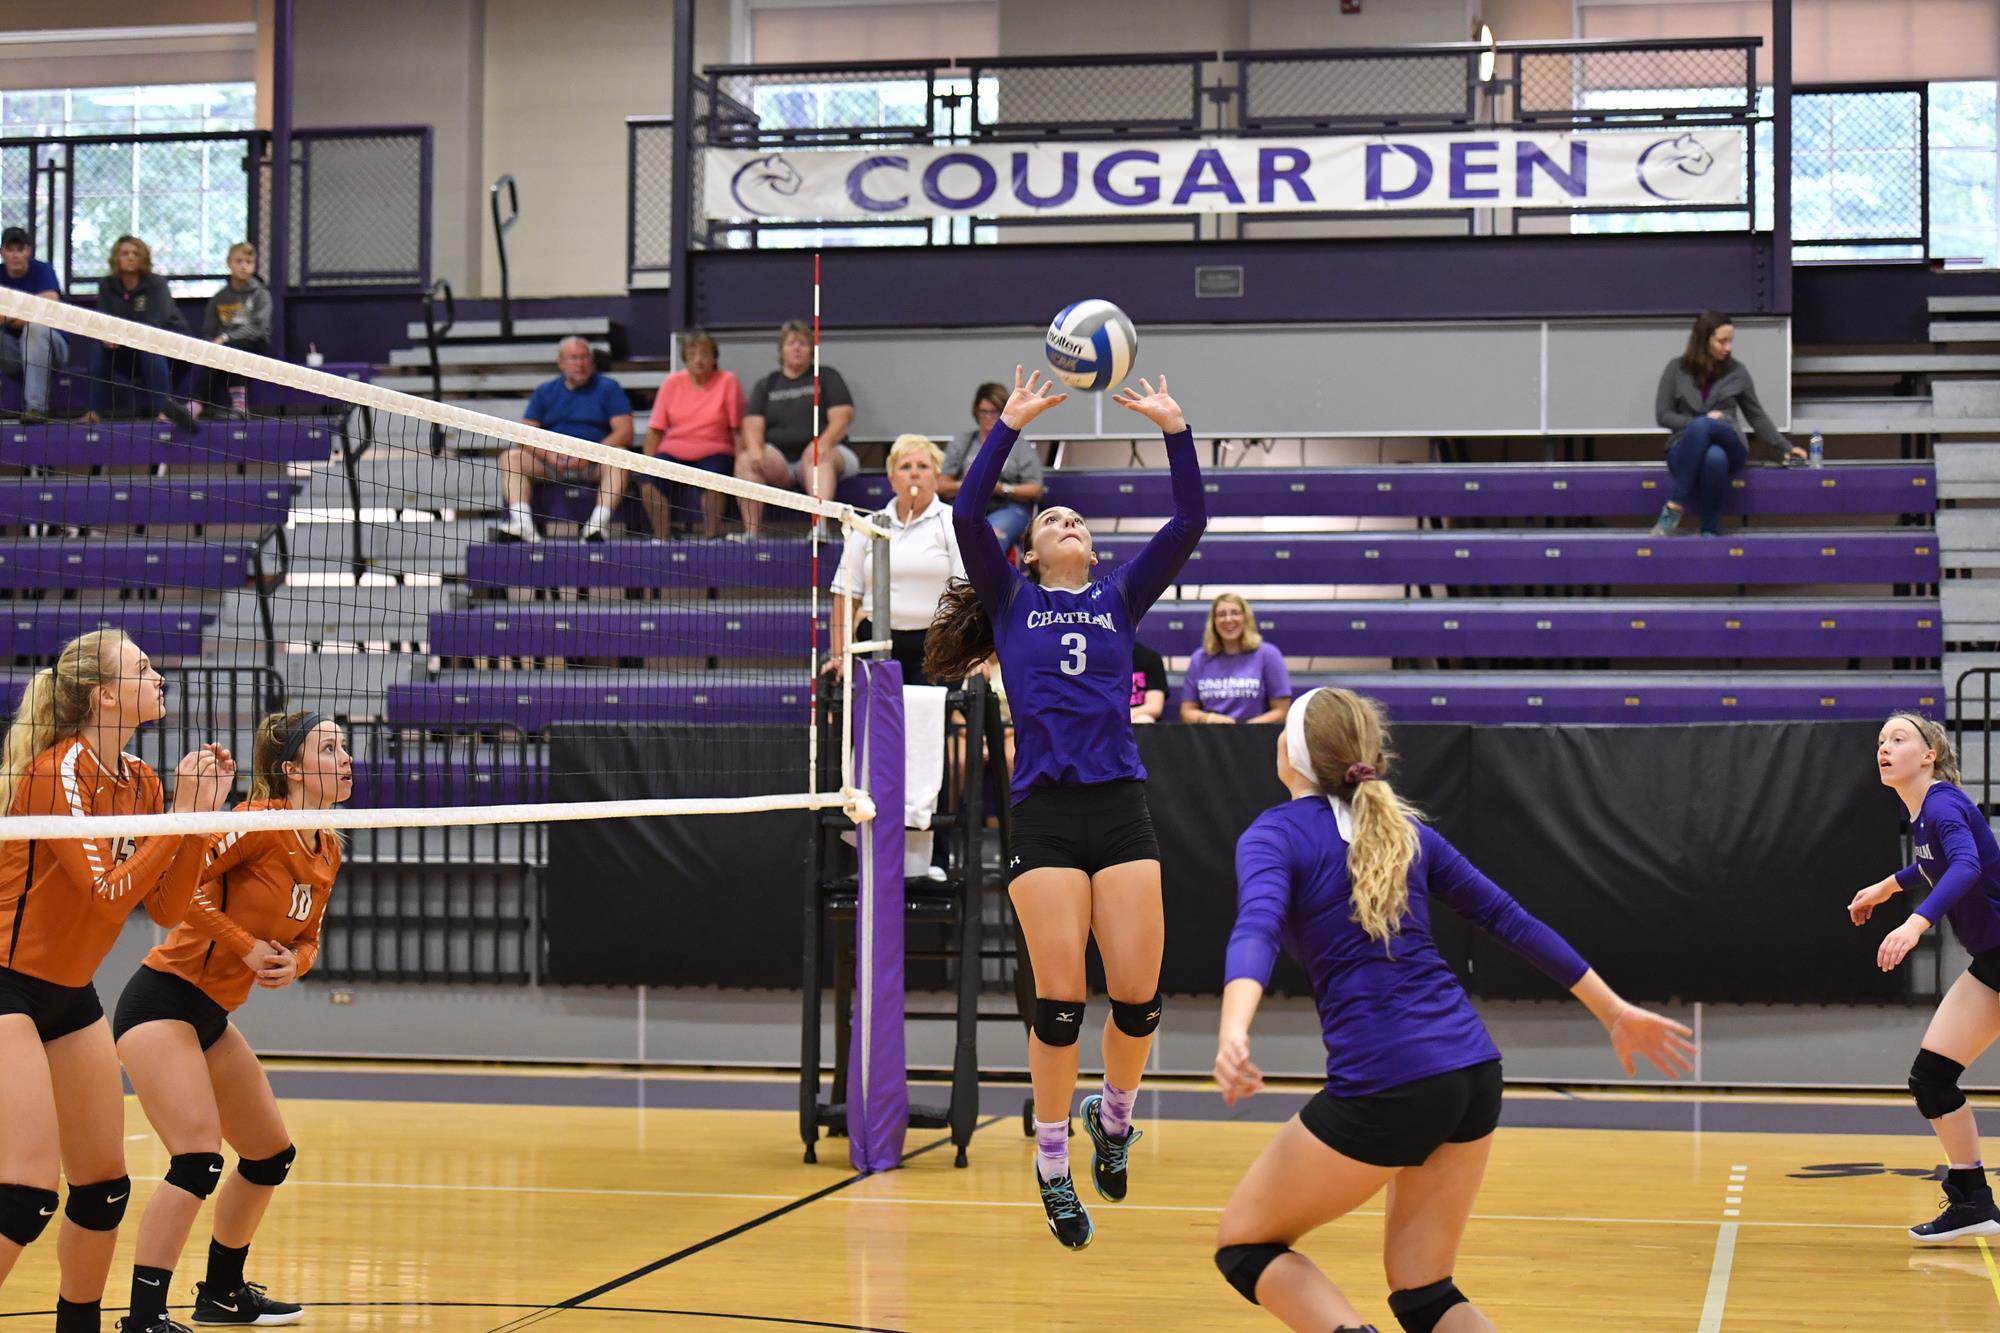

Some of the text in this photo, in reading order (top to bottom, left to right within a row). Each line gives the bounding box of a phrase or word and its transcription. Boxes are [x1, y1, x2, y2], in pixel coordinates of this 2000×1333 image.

[846, 140, 1588, 211] COUGAR DEN
[1060, 632, 1087, 676] 3
[287, 881, 313, 922] 10
